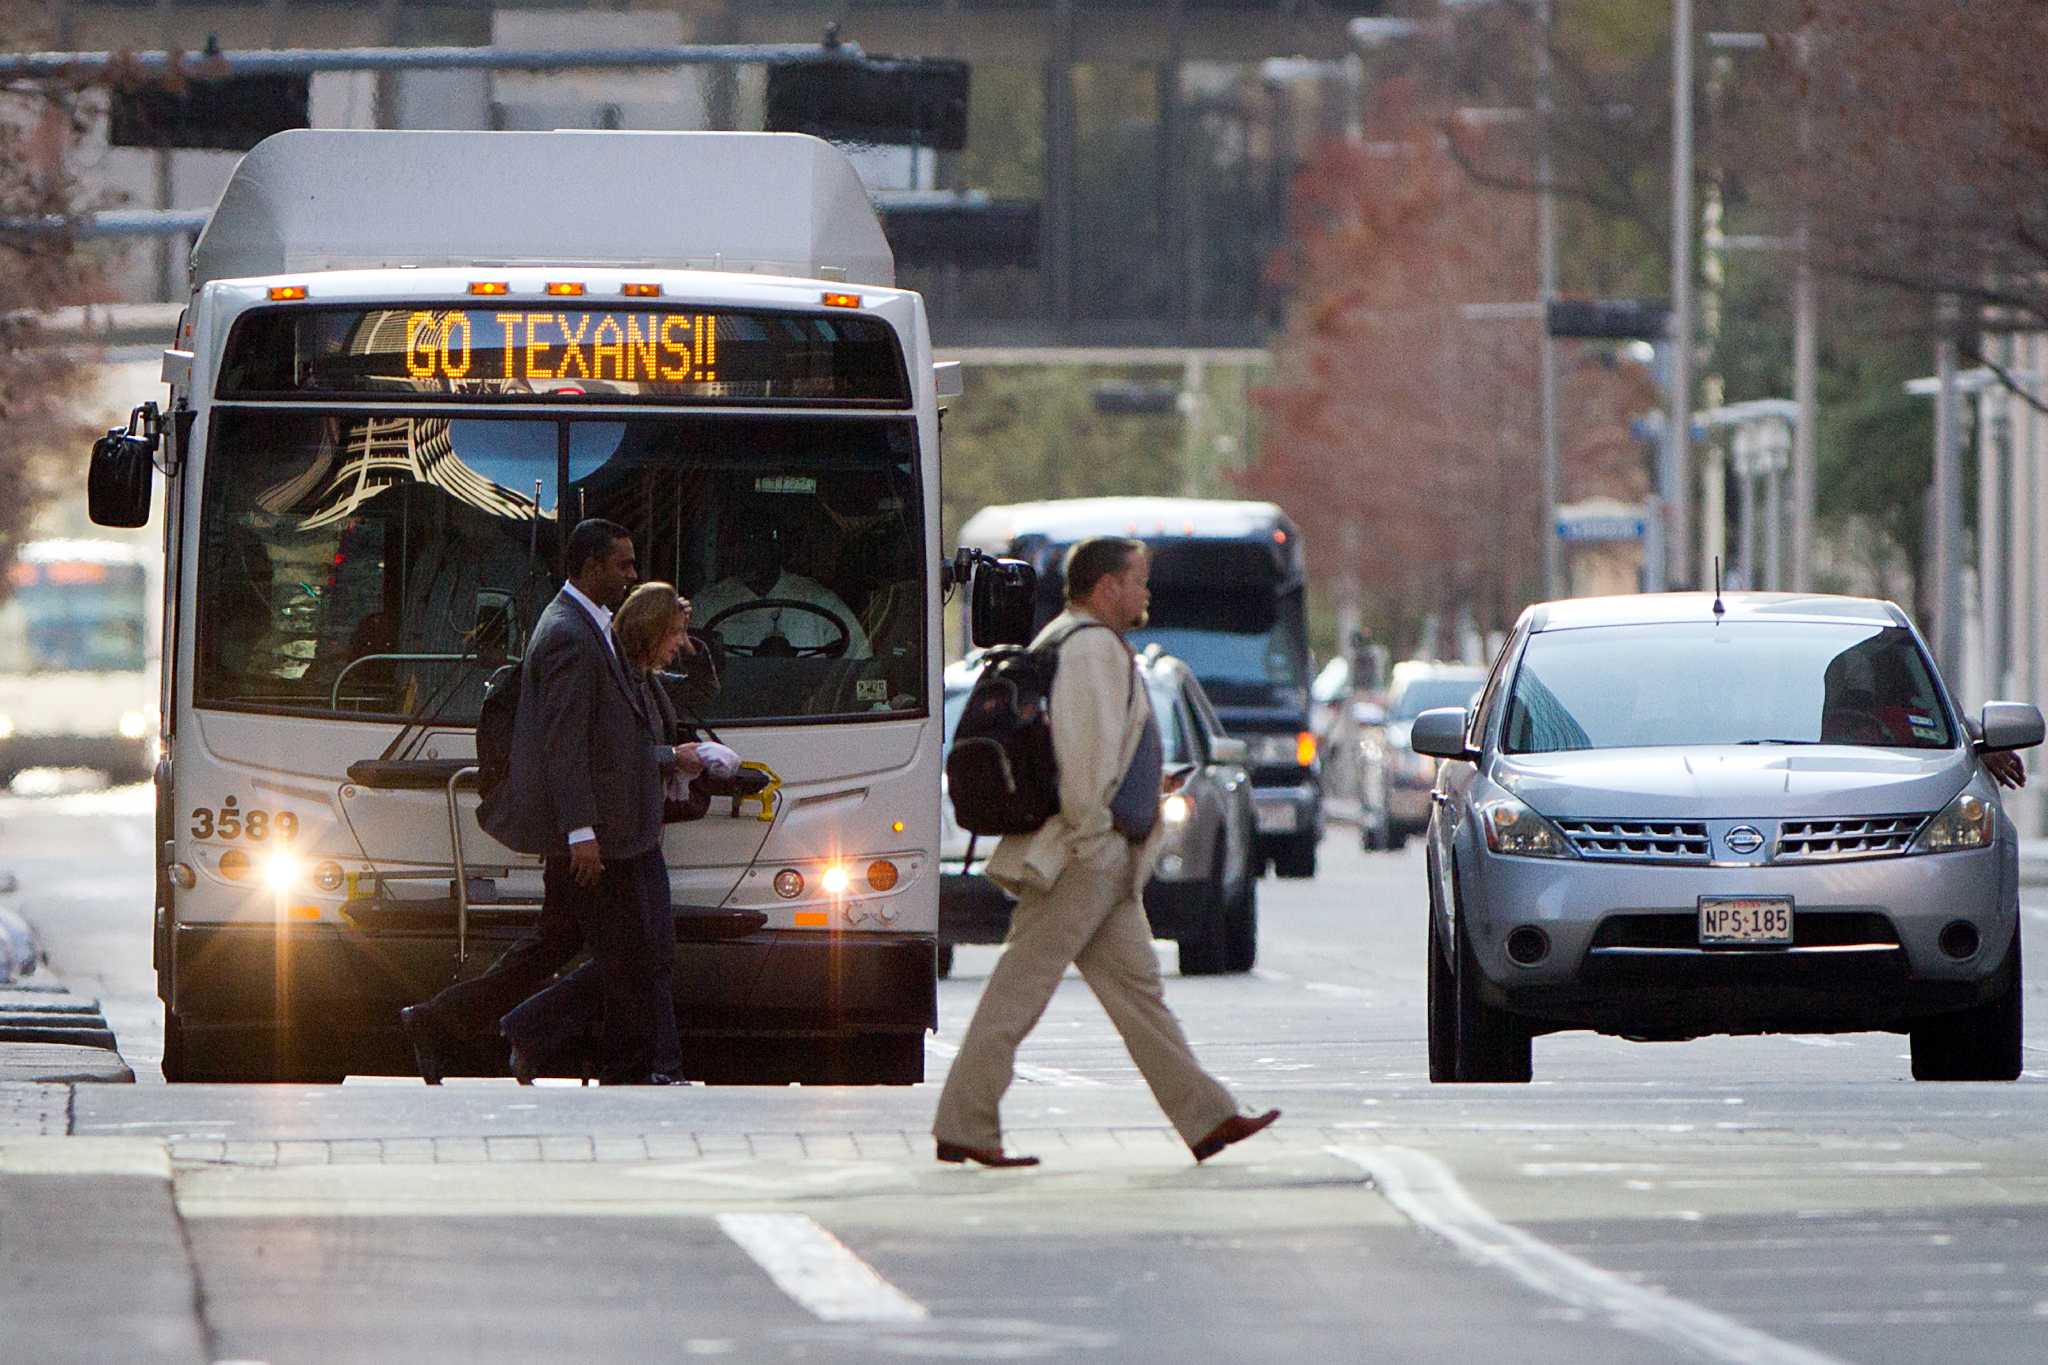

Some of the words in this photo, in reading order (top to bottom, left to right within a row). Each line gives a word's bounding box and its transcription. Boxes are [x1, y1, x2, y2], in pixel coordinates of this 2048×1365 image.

[406, 311, 471, 378] GO
[496, 313, 716, 381] TEXANS!!
[191, 808, 299, 842] 3589
